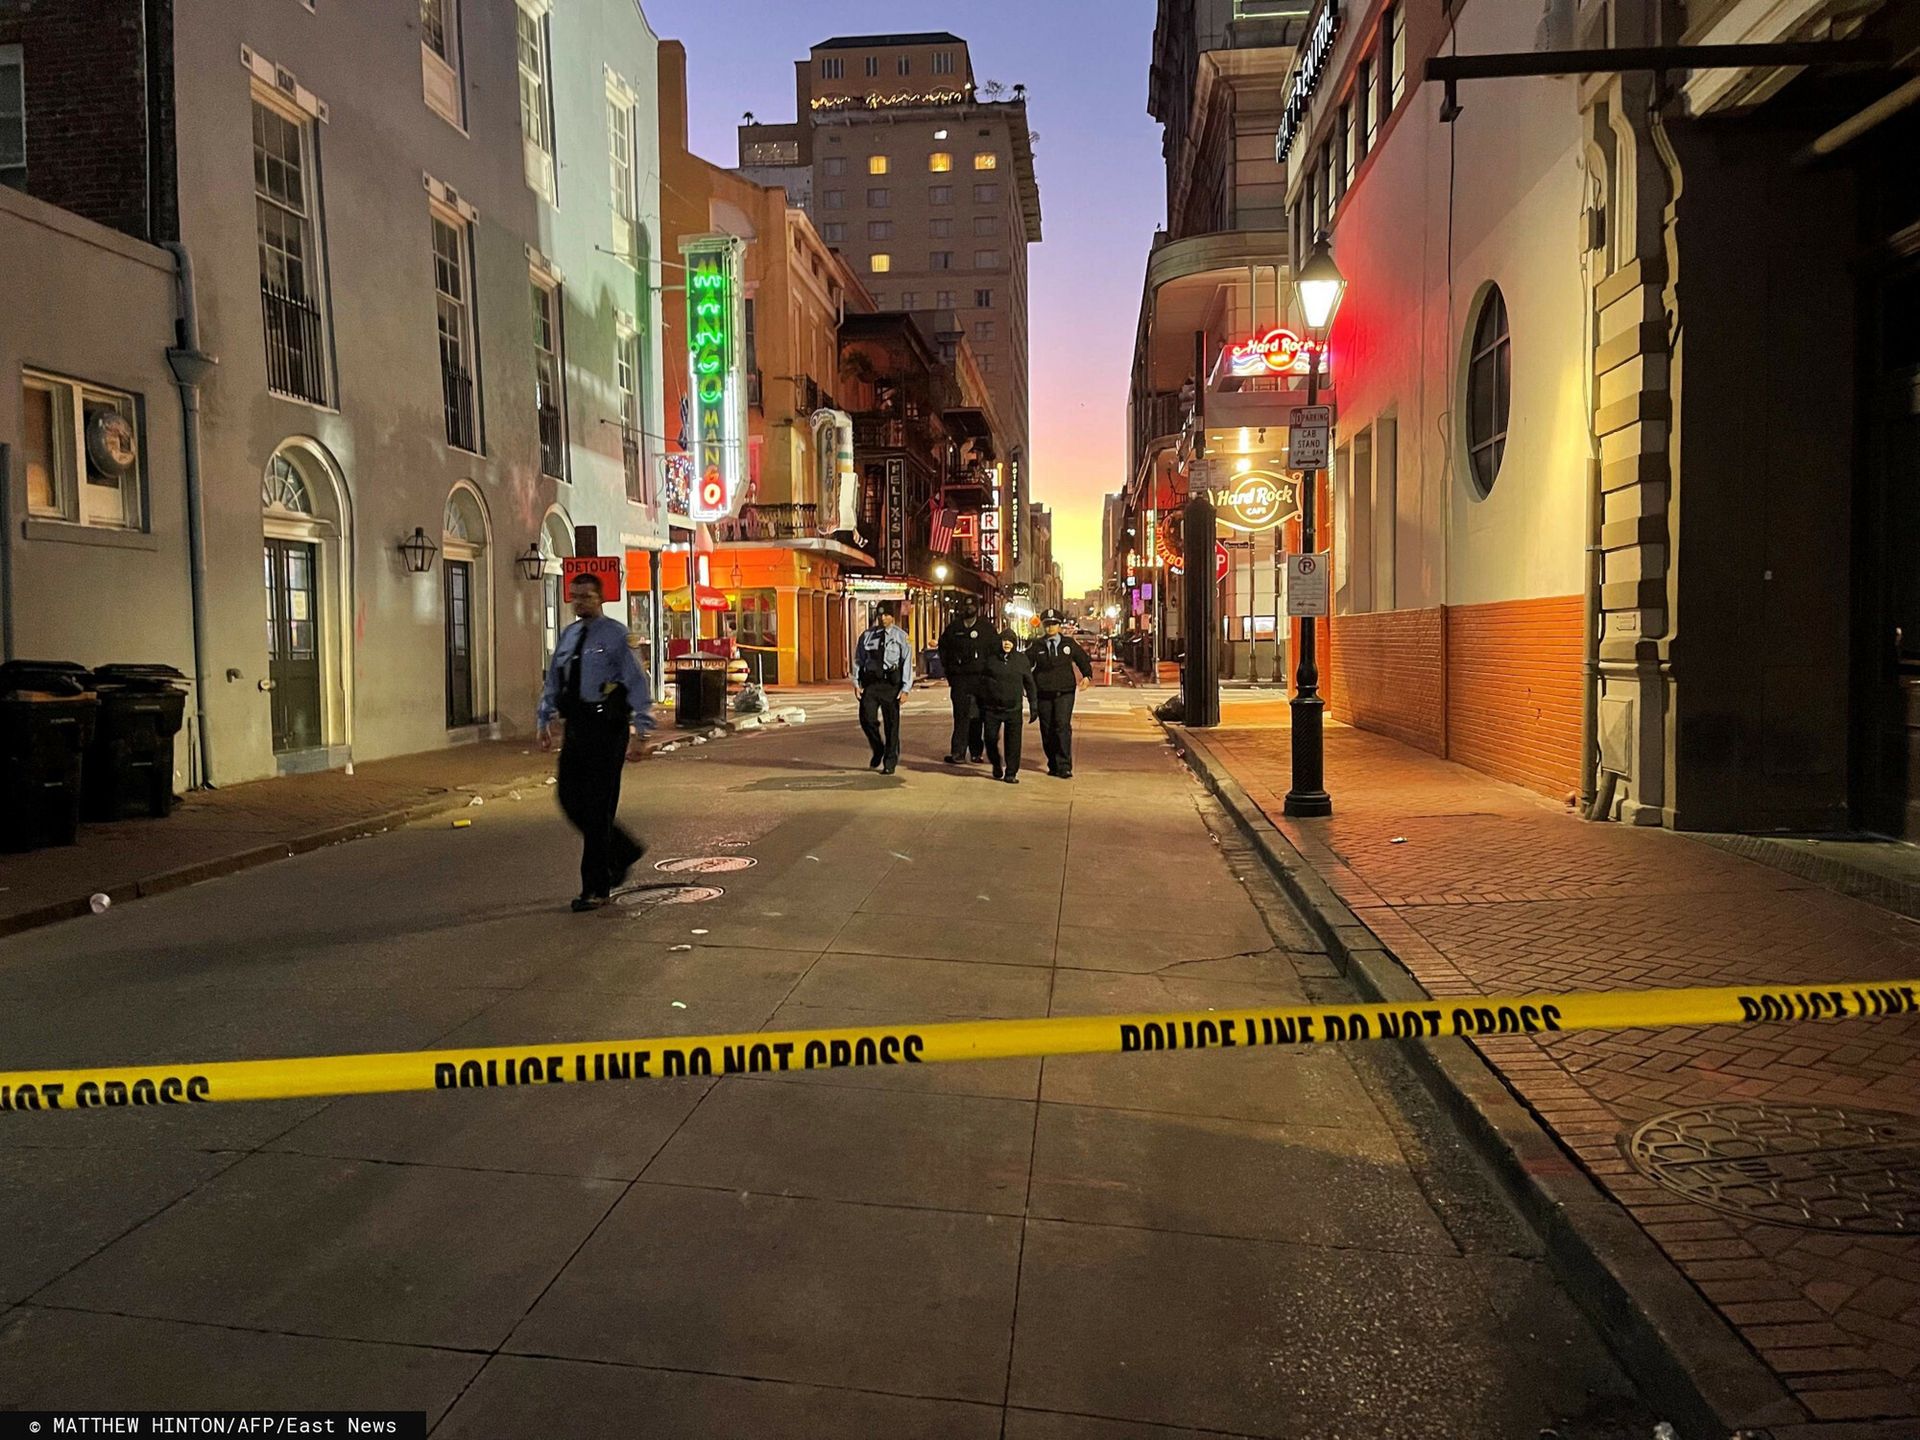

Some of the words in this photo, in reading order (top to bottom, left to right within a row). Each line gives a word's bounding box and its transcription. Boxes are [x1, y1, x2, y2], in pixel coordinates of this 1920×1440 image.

[692, 258, 723, 403] MANGO
[1246, 338, 1279, 354] Hard
[1302, 413, 1329, 421] PARKING
[1297, 440, 1321, 449] STAND
[1302, 430, 1317, 438] CAB
[702, 410, 721, 502] MANGO
[1217, 488, 1255, 506] Hard
[1256, 485, 1293, 506] Rock
[890, 538, 902, 570] BAR
[1154, 526, 1184, 569] BOURBO
[566, 560, 618, 574] DETOUR
[1737, 991, 1848, 1022] POLICE
[1120, 1019, 1236, 1052] POLICE
[1245, 1016, 1315, 1046] LINE
[1323, 1013, 1370, 1042] DO
[1378, 1010, 1442, 1040] NOT
[1452, 1004, 1562, 1036] CROSS
[435, 1056, 564, 1090] POLICE
[575, 1051, 651, 1081] LINE
[663, 1047, 712, 1077] DO
[723, 1042, 794, 1074] NOT
[804, 1034, 924, 1069] CROSS
[76, 1075, 211, 1108] CROSS
